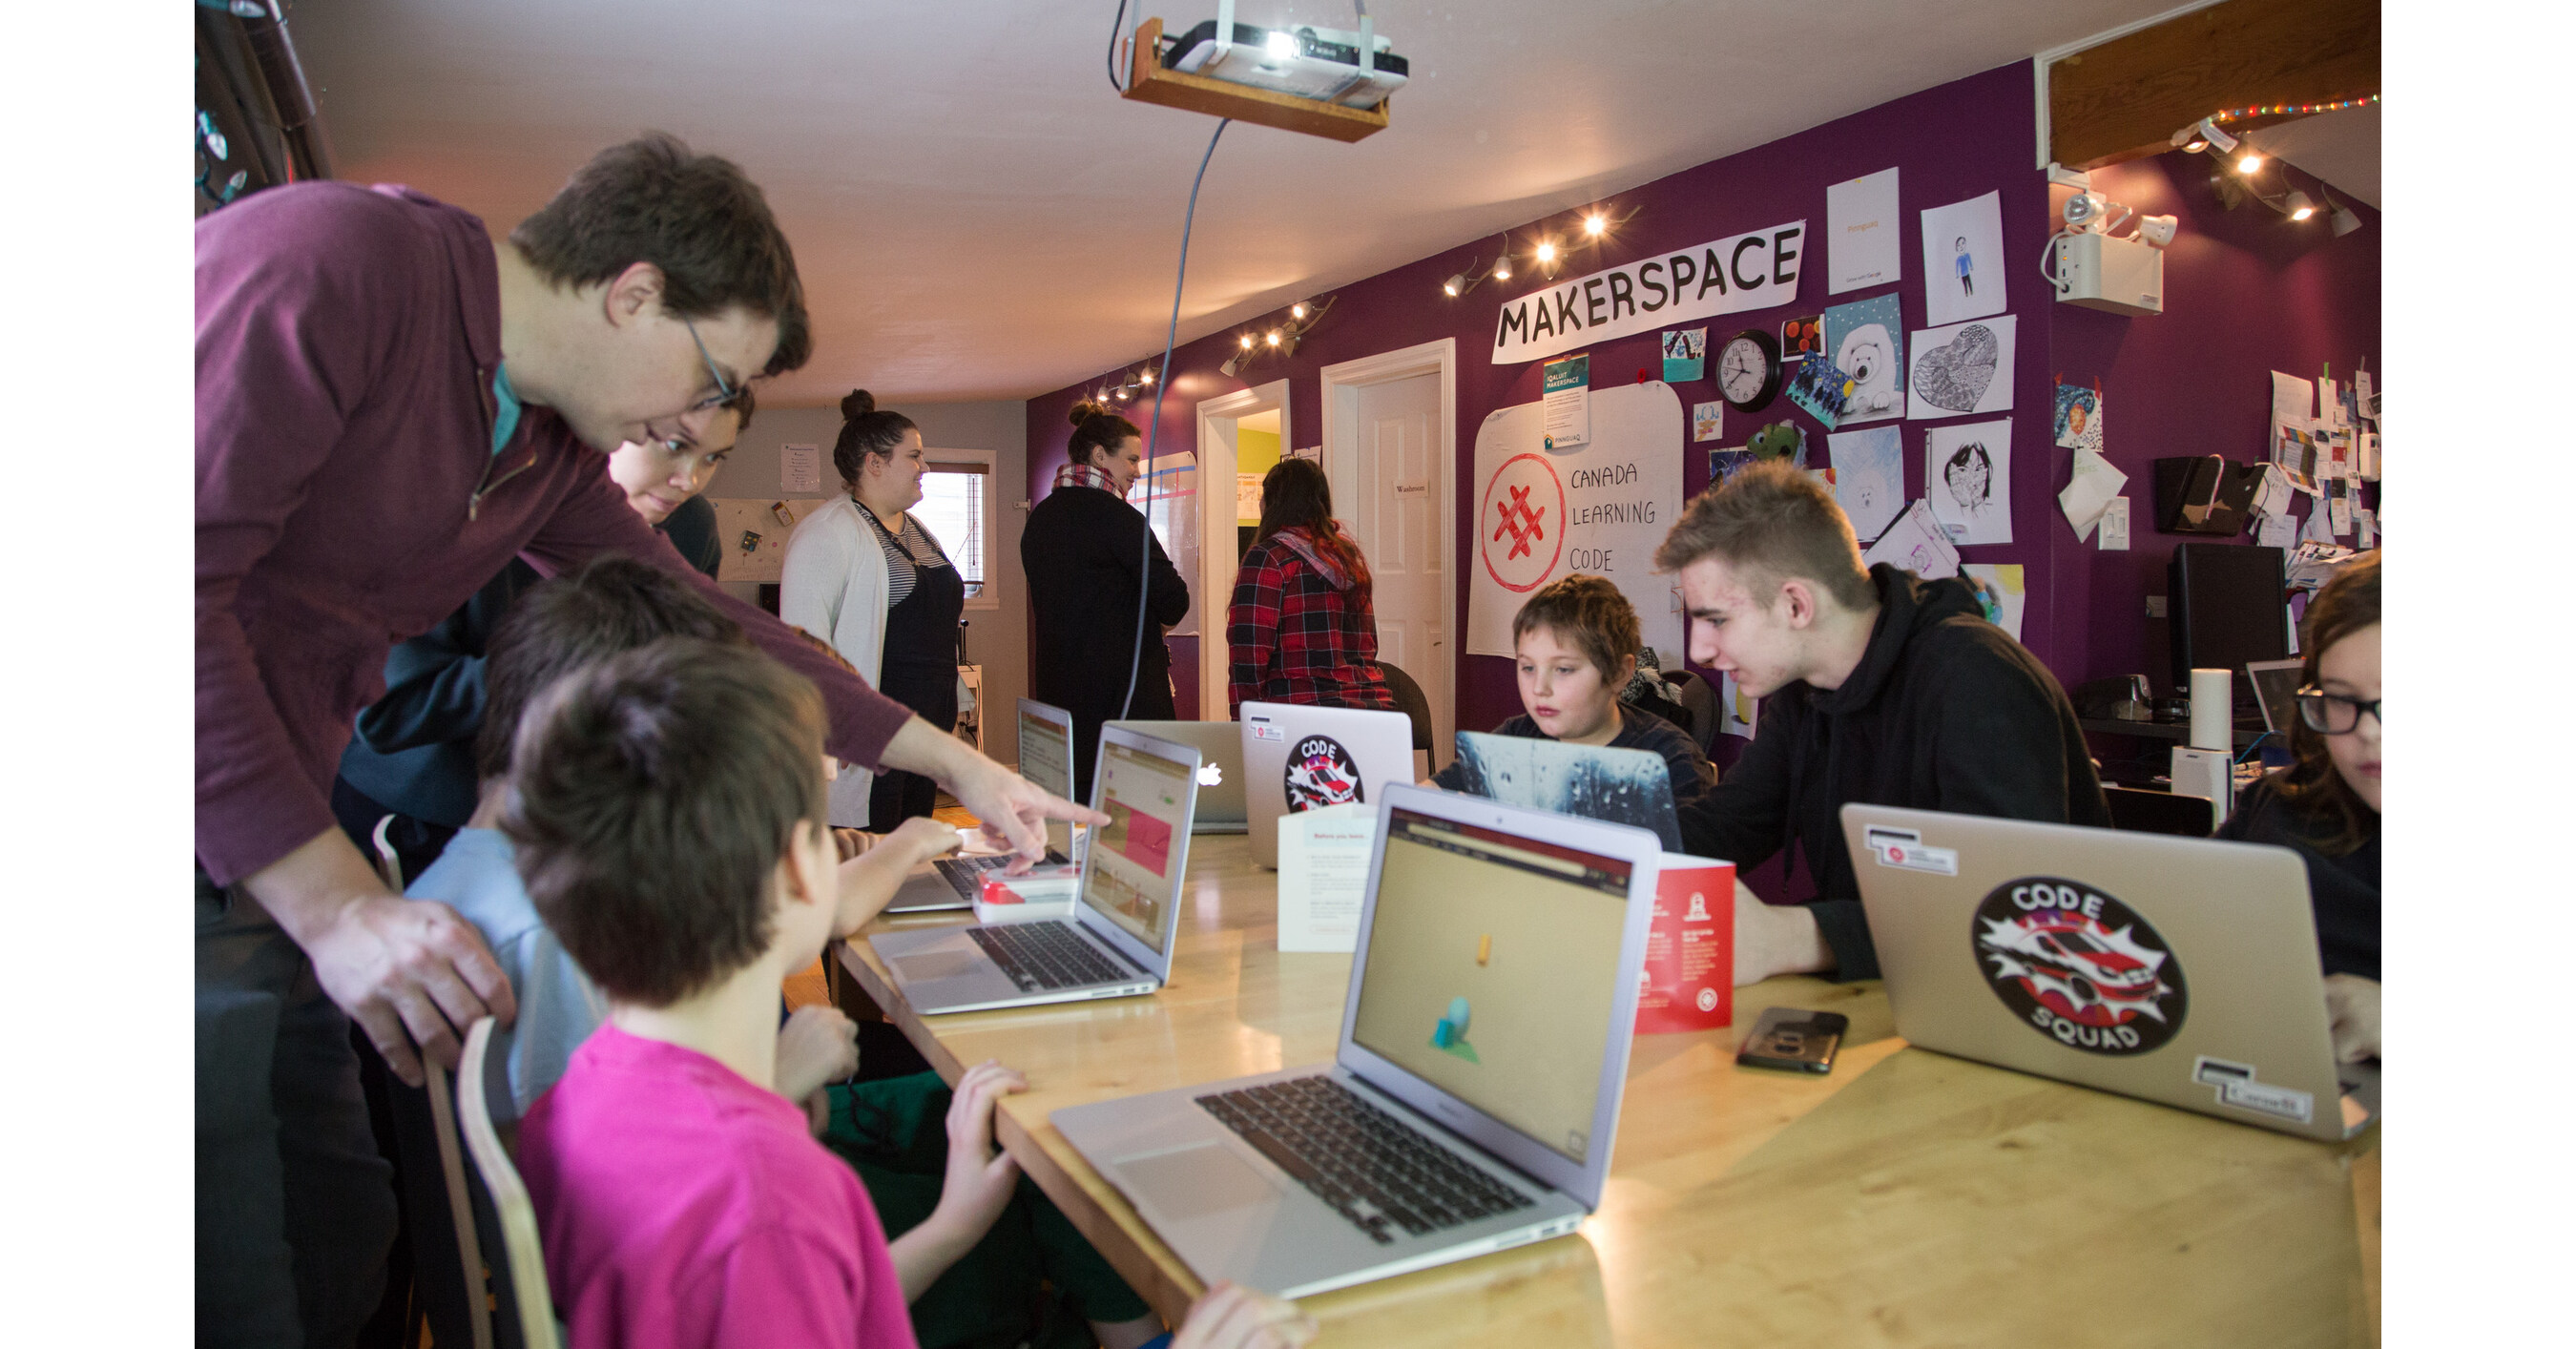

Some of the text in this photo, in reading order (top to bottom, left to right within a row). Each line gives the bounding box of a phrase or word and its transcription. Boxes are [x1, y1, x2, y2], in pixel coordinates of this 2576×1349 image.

[1498, 227, 1800, 348] MAKERSPACE
[1547, 372, 1568, 383] IQALUIT
[1547, 376, 1580, 388] MAKERSPACE
[1555, 434, 1581, 444] PINNGUAQ
[1571, 463, 1637, 488] CANADA
[1572, 501, 1655, 526] LEARNING
[1570, 548, 1613, 571] CODE
[1301, 739, 1337, 760] CODE
[2011, 882, 2105, 921] CODE
[2030, 1006, 2140, 1049] SQUAD
